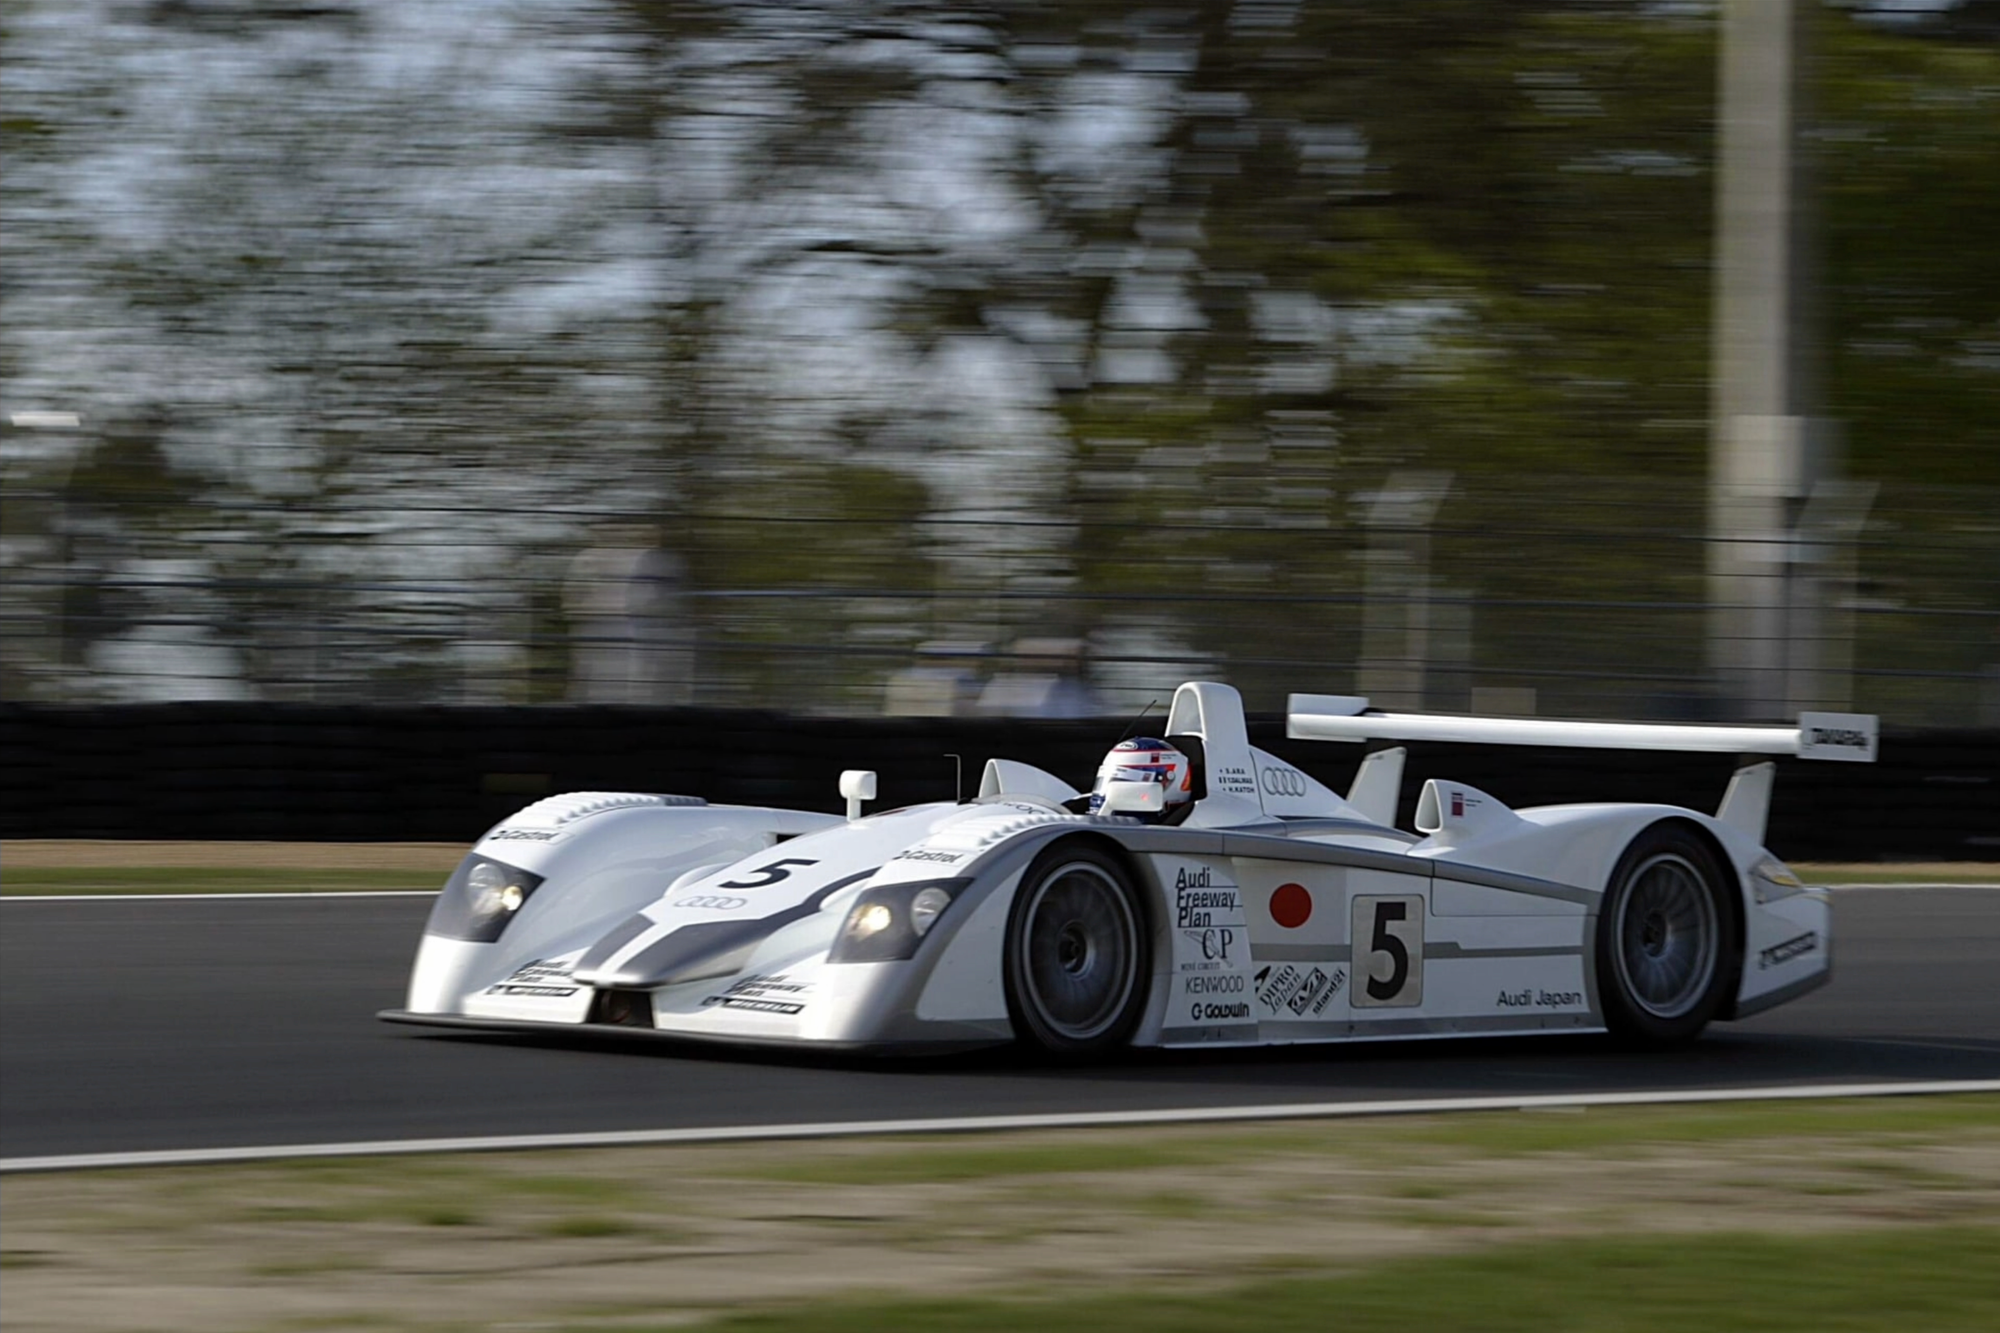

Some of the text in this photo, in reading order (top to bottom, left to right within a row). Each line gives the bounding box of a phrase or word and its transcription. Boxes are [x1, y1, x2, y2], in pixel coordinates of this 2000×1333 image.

[905, 850, 964, 863] Castrol
[718, 858, 820, 889] 5
[1175, 867, 1211, 889] Audi
[1175, 887, 1236, 912] Freeway
[1177, 906, 1212, 928] Plan
[1366, 901, 1408, 1001] 5
[1185, 975, 1244, 994] KENWOOD
[1259, 964, 1295, 1006] DIPRO
[1270, 972, 1301, 1016] Japan
[1496, 989, 1582, 1009] Audi Japan
